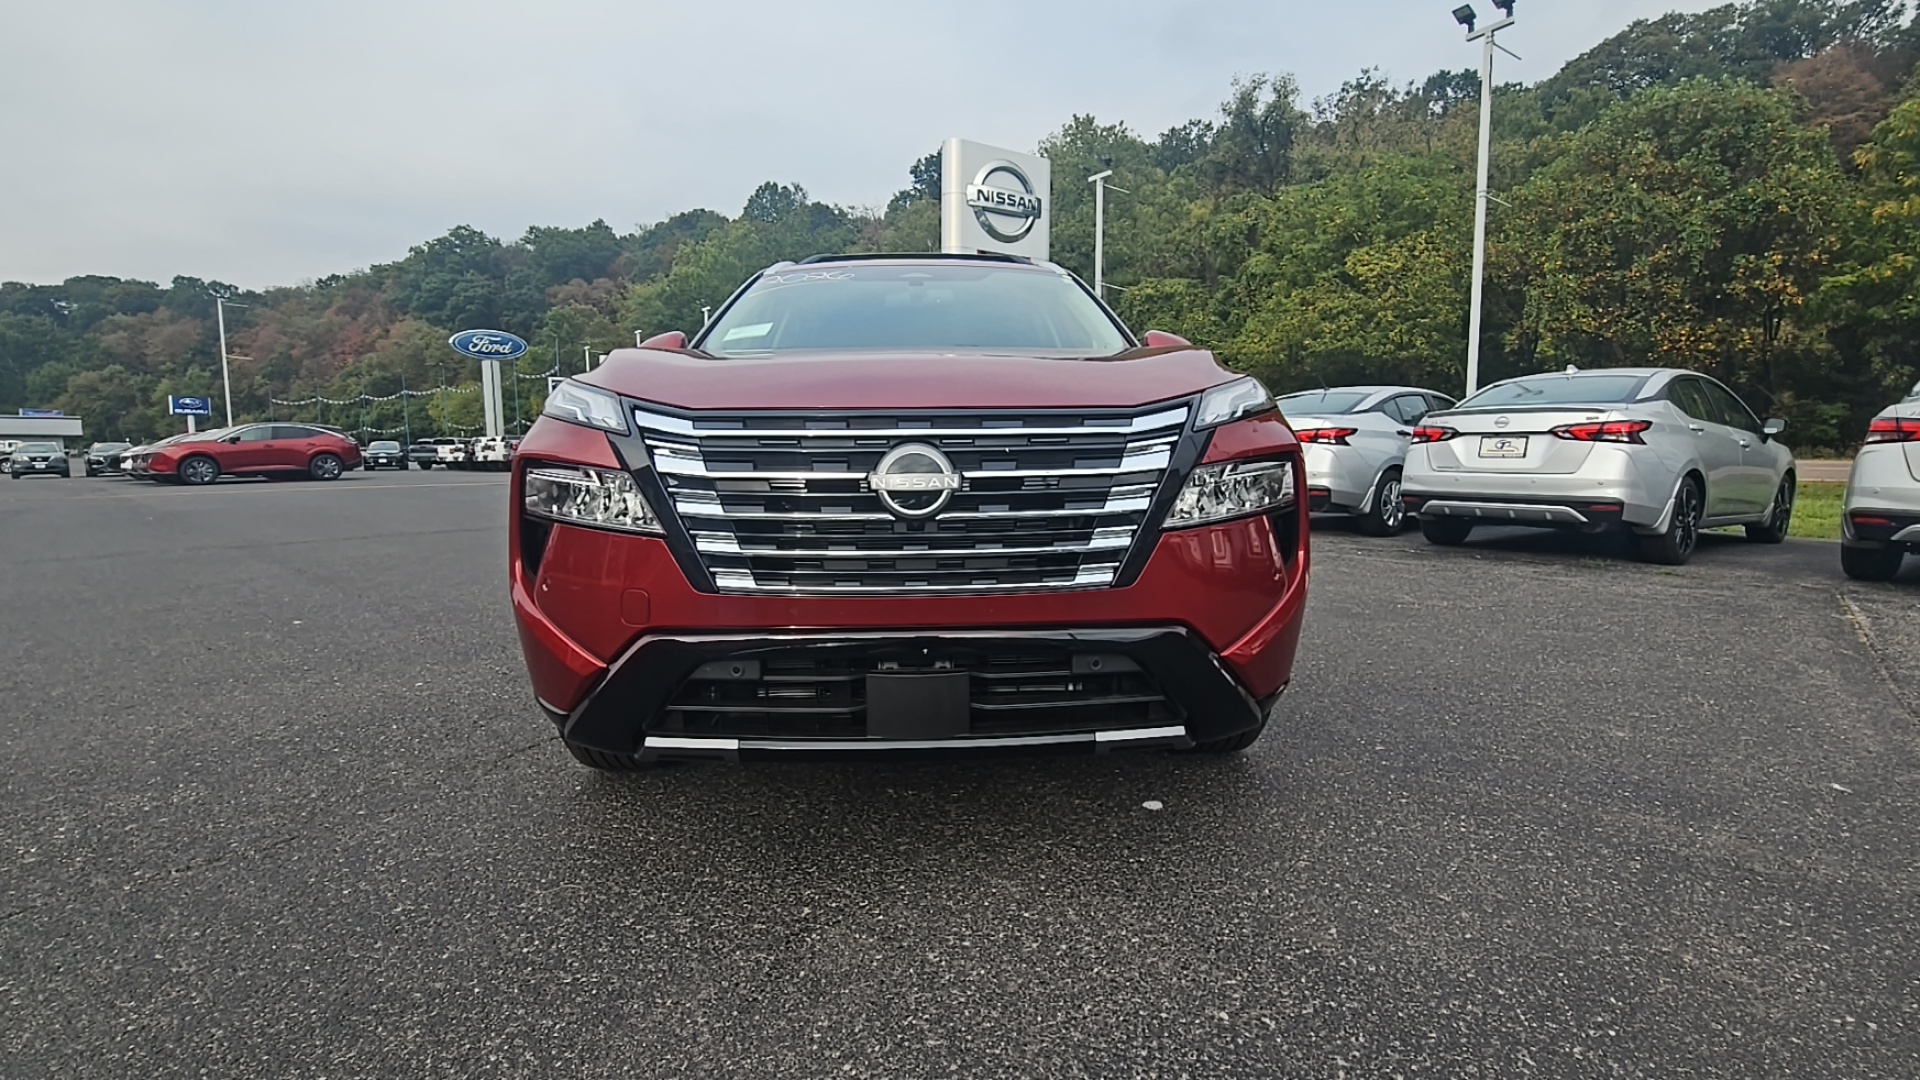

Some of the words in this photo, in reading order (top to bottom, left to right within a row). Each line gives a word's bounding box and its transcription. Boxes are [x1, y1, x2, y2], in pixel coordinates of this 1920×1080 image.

[977, 189, 1038, 211] NISSAN
[468, 335, 514, 354] Ford
[872, 476, 957, 489] NISSAN
